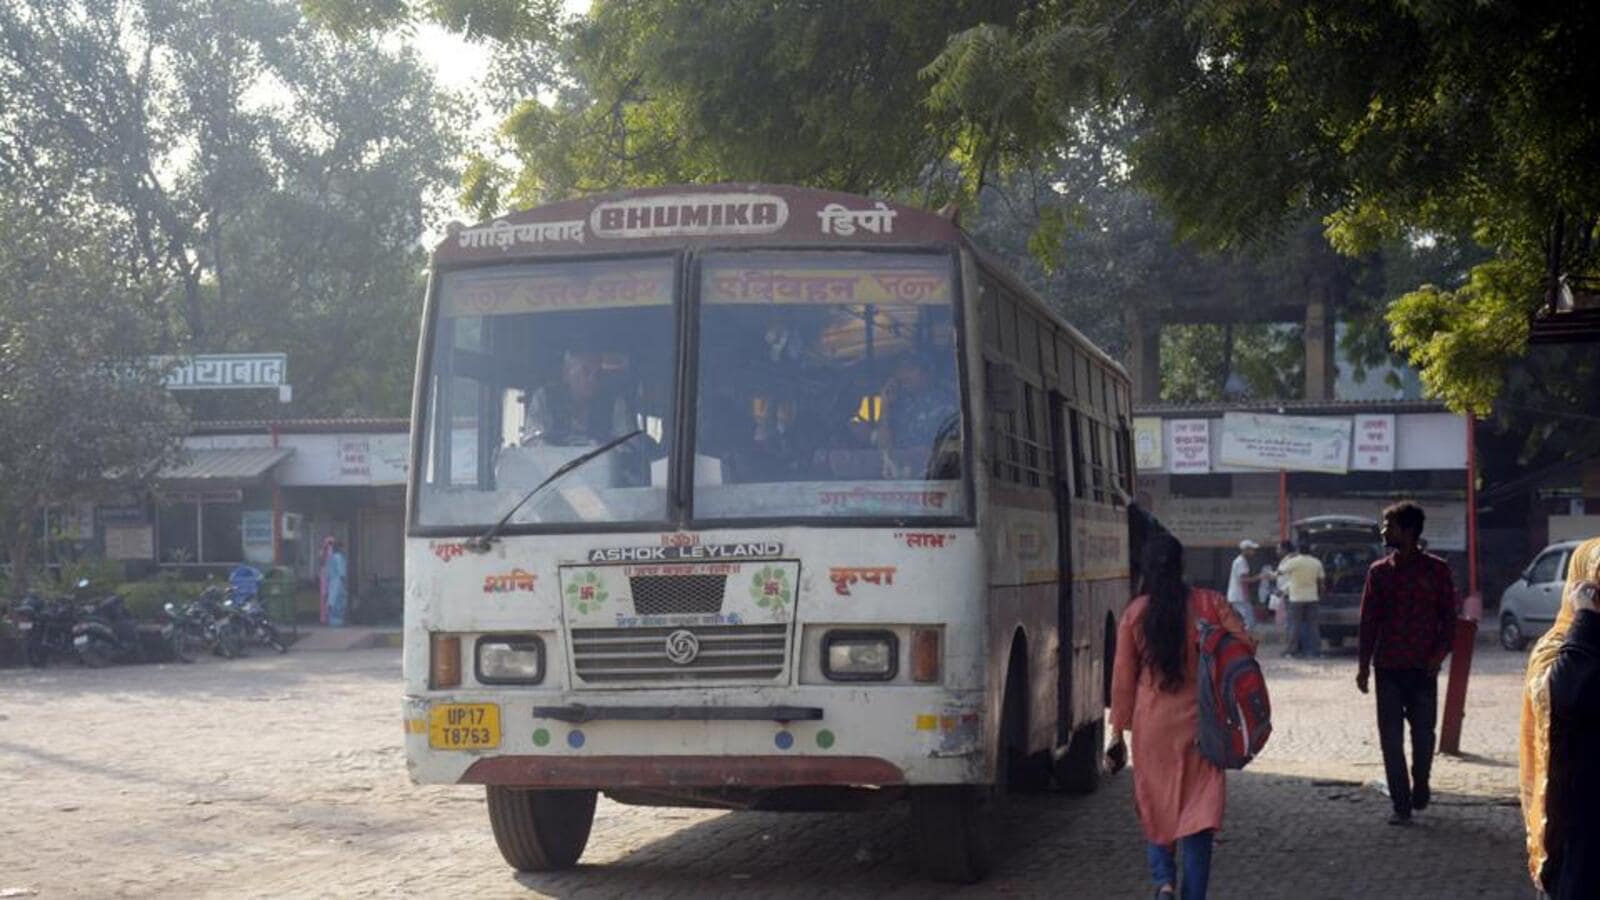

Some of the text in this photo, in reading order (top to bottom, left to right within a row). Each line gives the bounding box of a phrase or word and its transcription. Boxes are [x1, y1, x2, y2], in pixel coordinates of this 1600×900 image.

[602, 201, 778, 230] BHUMIKA
[816, 203, 898, 236] डिपो
[592, 541, 780, 562] ASHOK LEYLAND
[829, 566, 897, 596] कृपा
